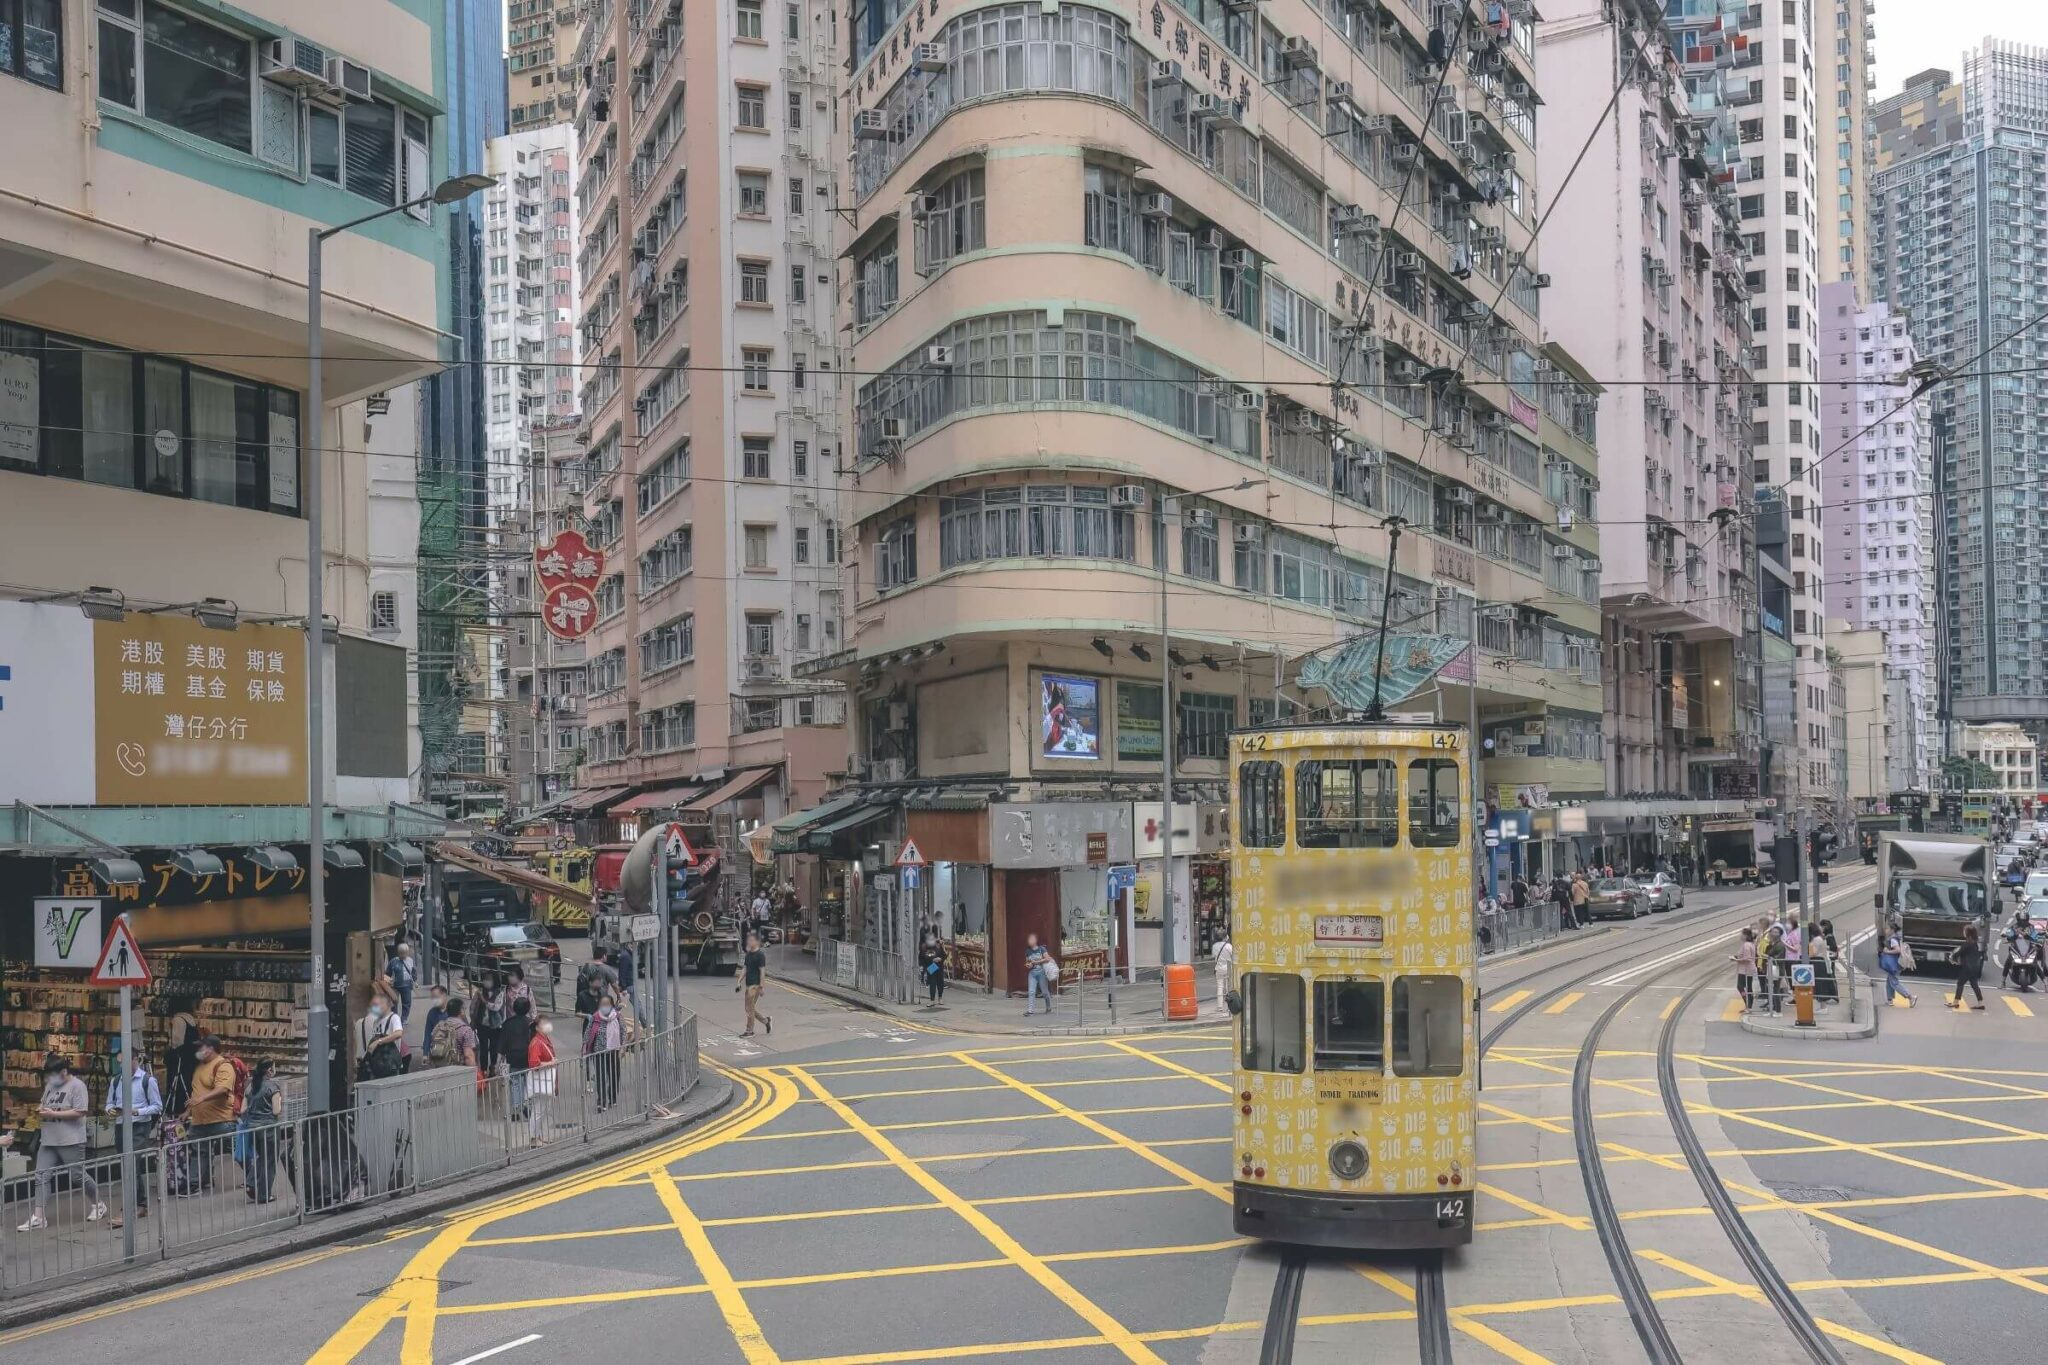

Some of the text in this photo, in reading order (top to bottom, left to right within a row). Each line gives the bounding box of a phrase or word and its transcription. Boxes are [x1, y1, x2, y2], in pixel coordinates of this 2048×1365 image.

[552, 591, 590, 633] 押
[121, 639, 285, 675] 港股 美股 期貨
[121, 670, 286, 703] 期權 基金 保險
[164, 714, 249, 741] 灣仔分行
[1242, 735, 1267, 751] 142
[1432, 733, 1457, 749] 142
[1319, 1089, 1379, 1099] UNDER TRAINING
[1436, 1199, 1465, 1218] 142
